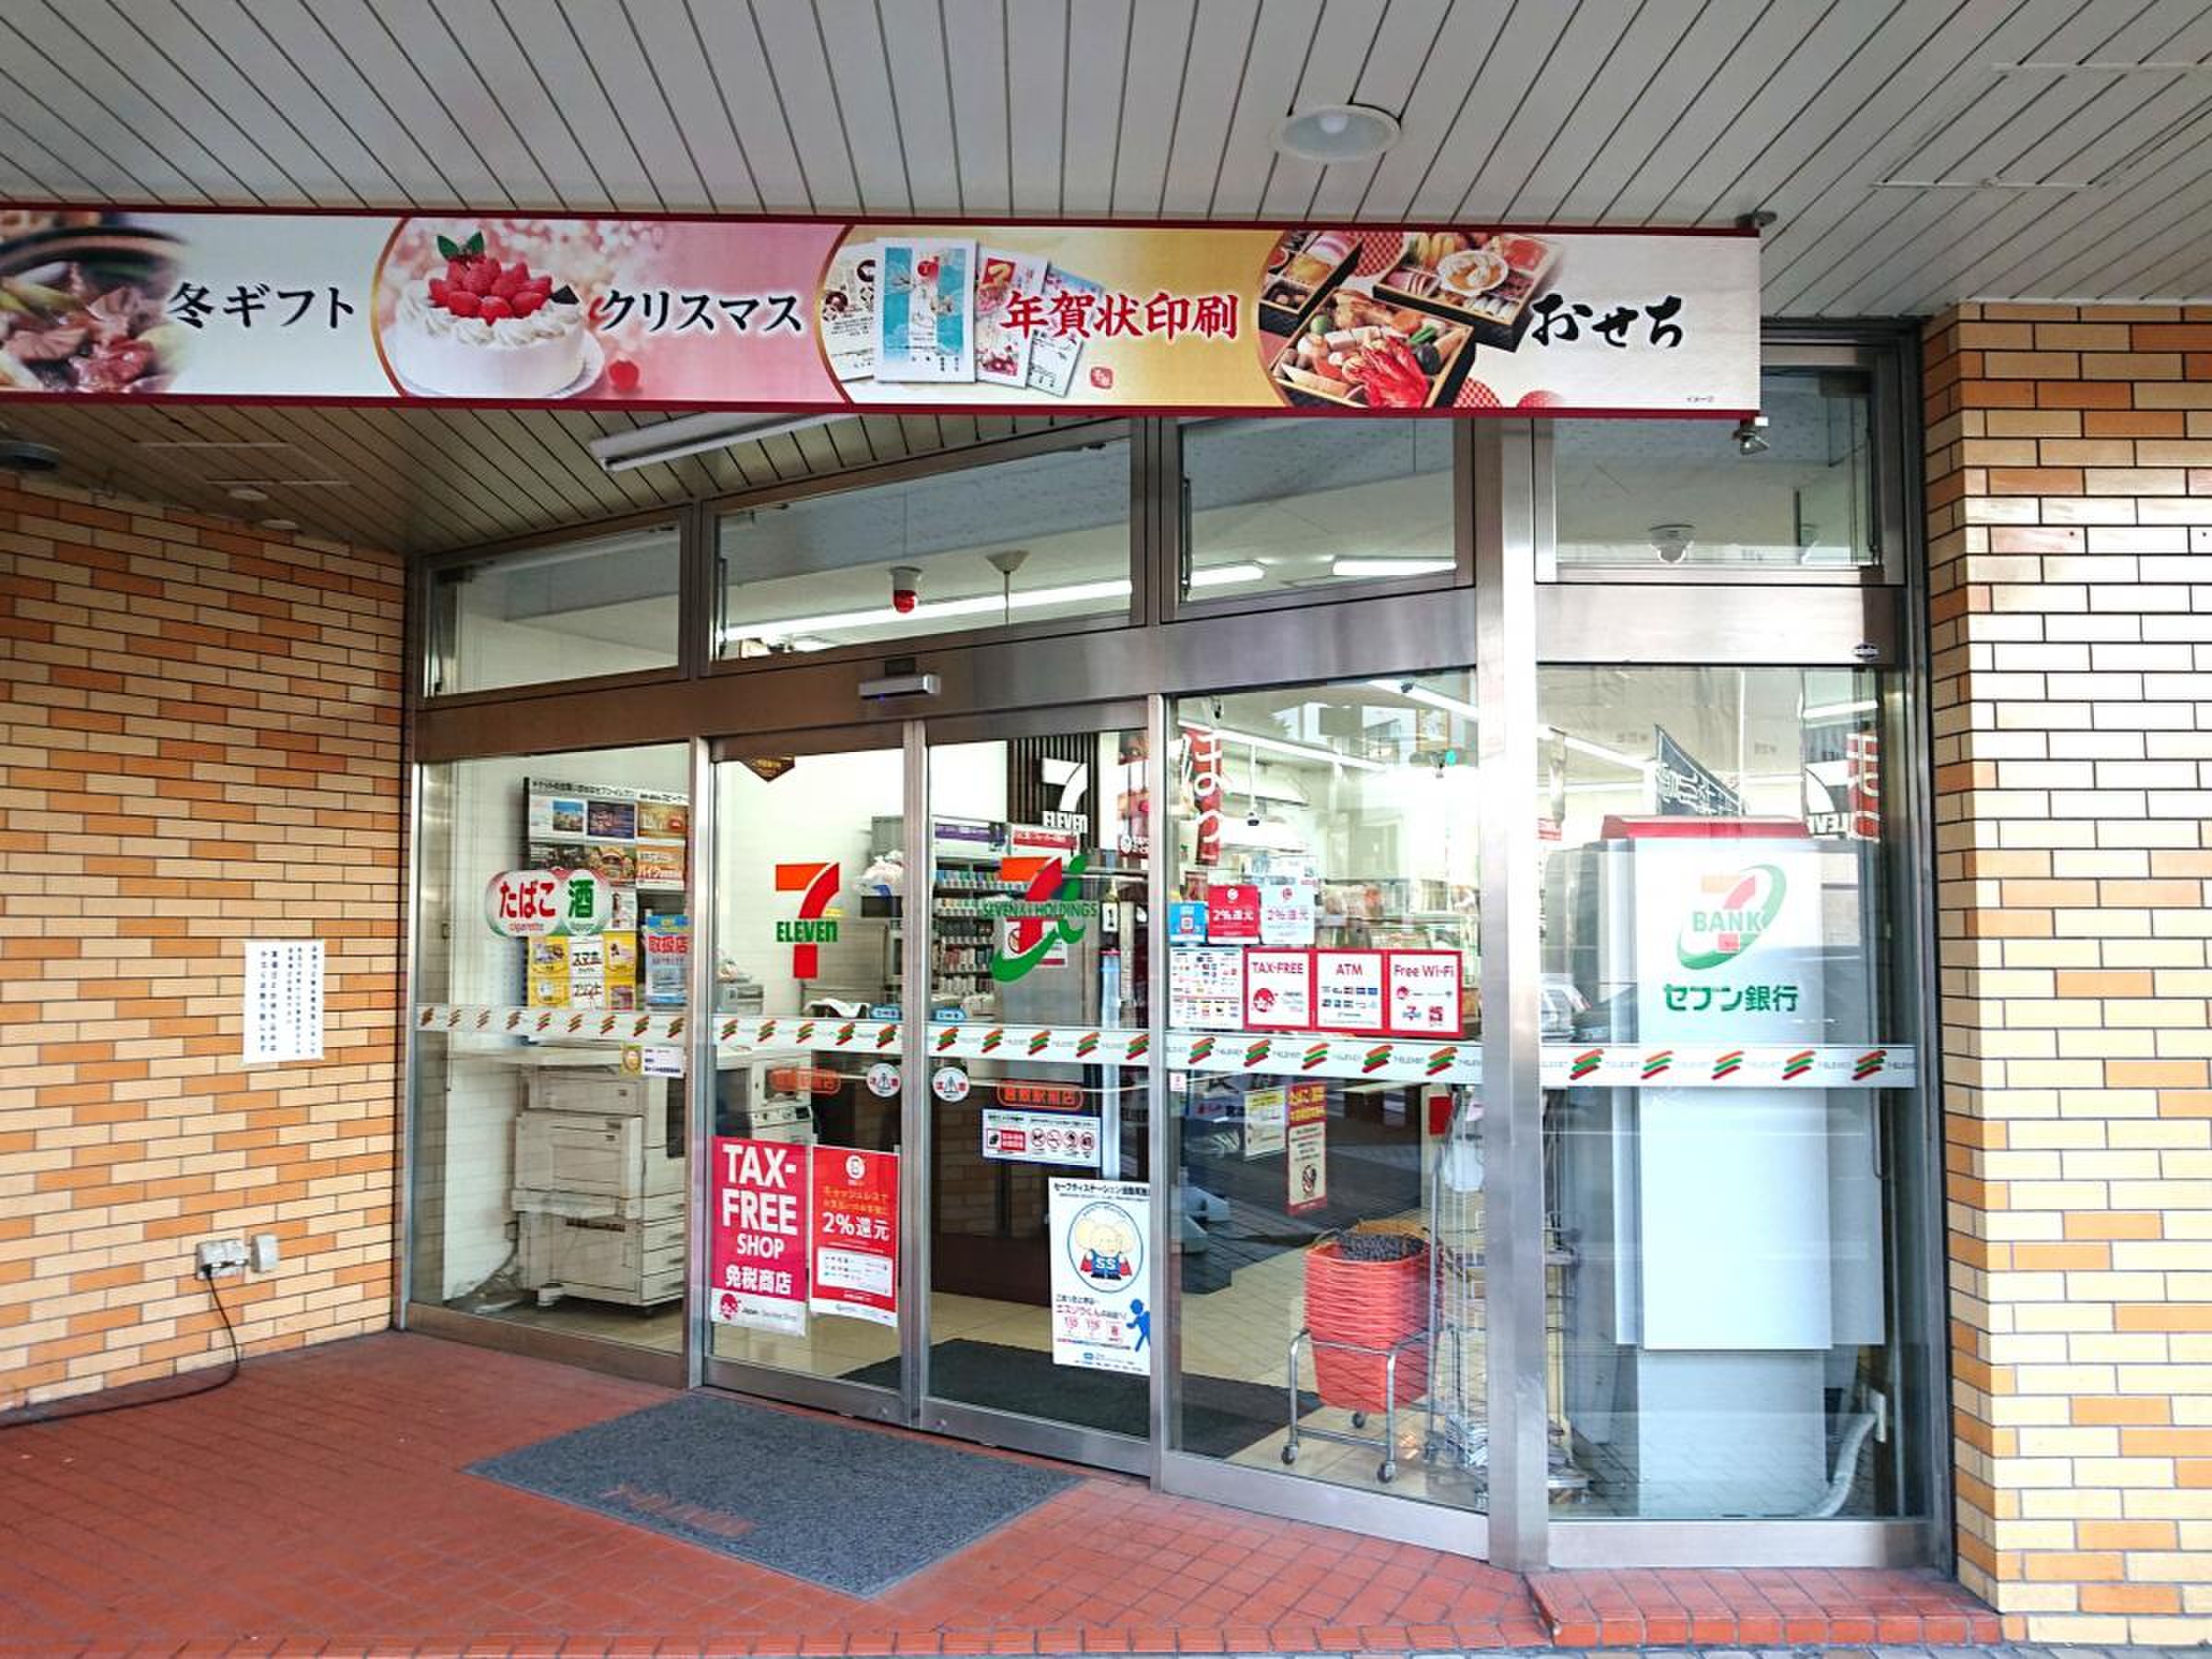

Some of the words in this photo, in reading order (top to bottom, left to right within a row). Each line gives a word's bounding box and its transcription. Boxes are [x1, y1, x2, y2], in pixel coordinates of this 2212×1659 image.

[170, 281, 355, 330] 冬ギフト
[597, 288, 804, 333] クリスマス
[1000, 289, 1238, 341] 年賀状印刷
[1531, 293, 1686, 348] おせち
[499, 880, 557, 919] たばこ
[568, 879, 594, 919] 酒
[776, 921, 838, 942] ELEVEN
[1692, 910, 1765, 934] BANK
[1252, 961, 1303, 974] TAX-FREE
[1335, 963, 1363, 976] ATM
[1394, 964, 1419, 977] Free
[1422, 964, 1454, 978] Wi-Fi
[722, 1144, 797, 1188] TAX-
[722, 1188, 797, 1235] FREE
[736, 1233, 784, 1259] SHOP
